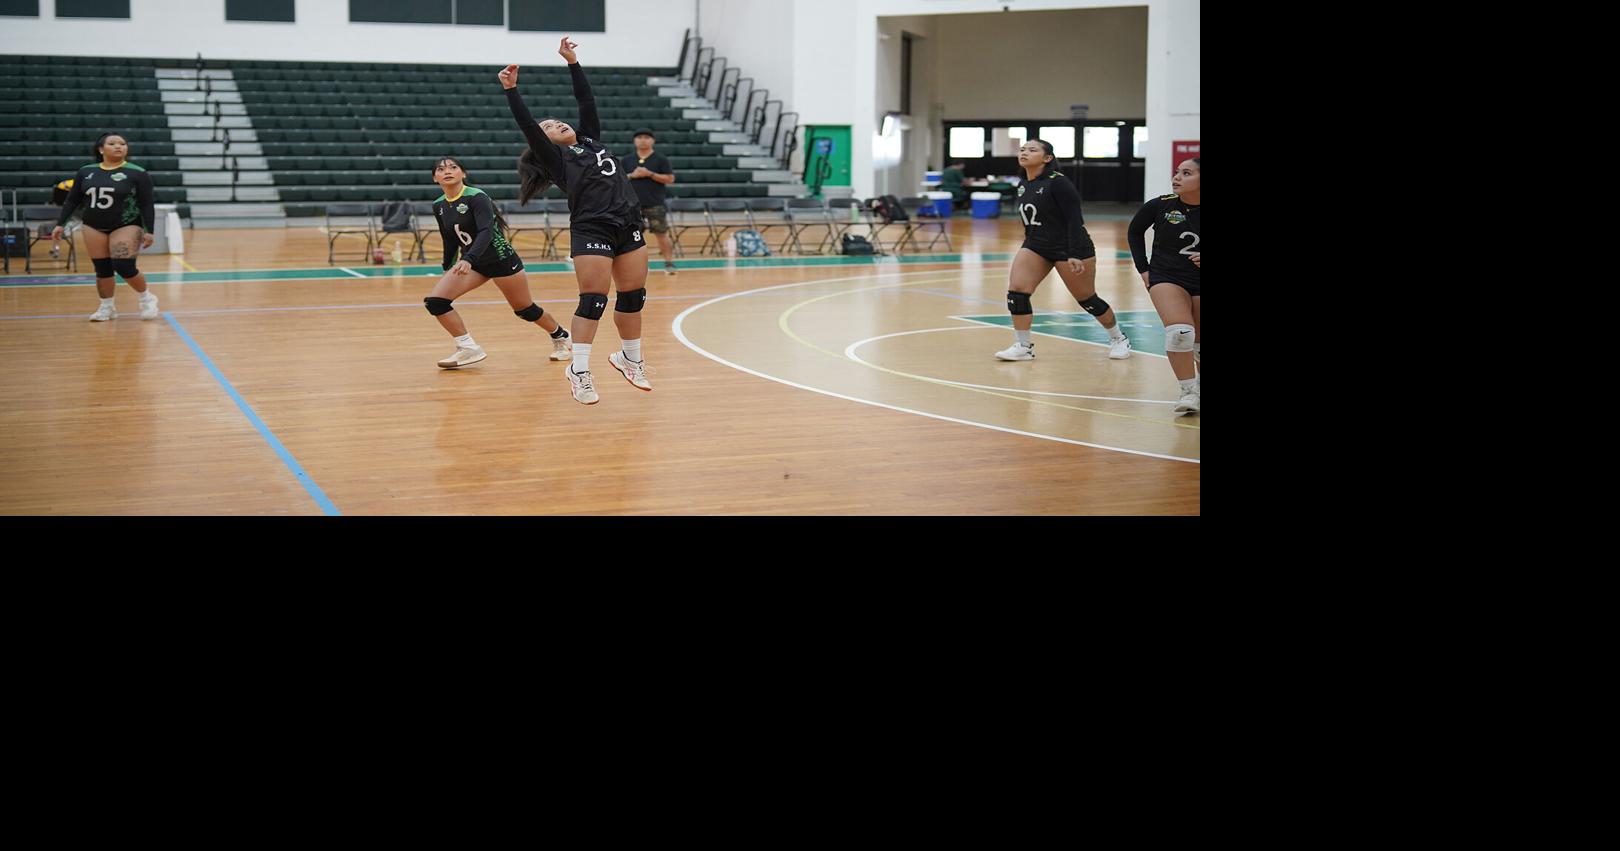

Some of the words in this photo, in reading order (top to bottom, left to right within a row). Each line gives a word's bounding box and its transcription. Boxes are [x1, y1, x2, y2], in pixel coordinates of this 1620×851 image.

[595, 149, 616, 176] 5
[85, 187, 115, 209] 15
[1019, 203, 1042, 226] 12
[454, 224, 472, 246] 6
[632, 230, 641, 241] 8
[1179, 231, 1200, 255] 2
